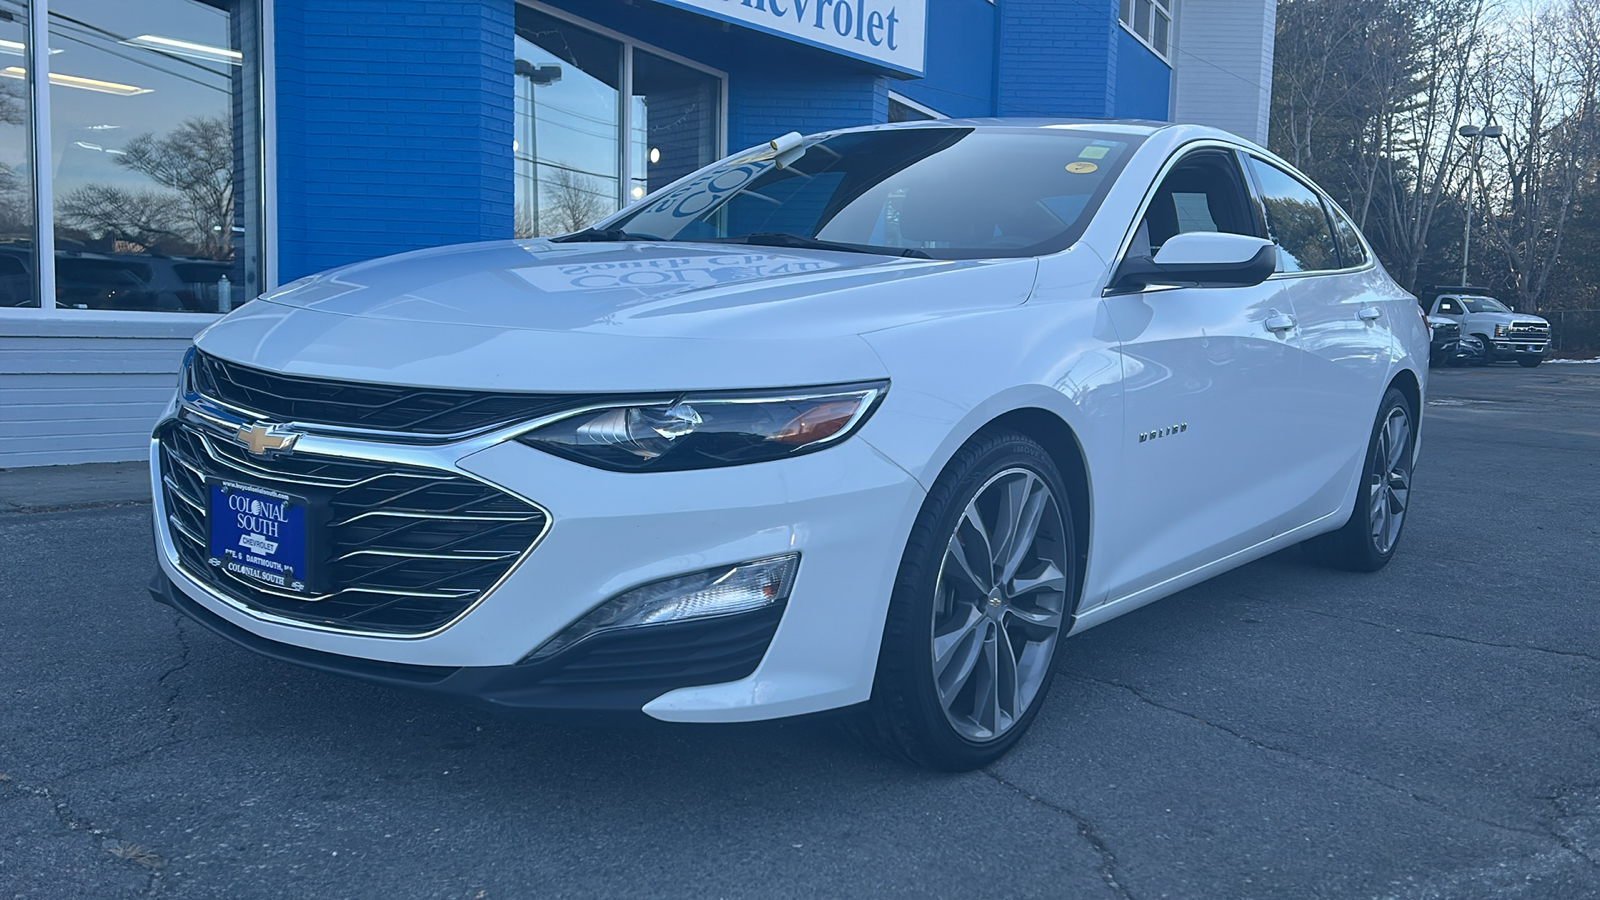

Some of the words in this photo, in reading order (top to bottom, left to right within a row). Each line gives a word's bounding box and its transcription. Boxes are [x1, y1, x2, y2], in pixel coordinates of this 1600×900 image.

[722, 0, 899, 51] vrolet
[1139, 422, 1187, 443] MALIBU
[229, 494, 288, 523] COLONIAL
[237, 513, 279, 537] SOUTH
[242, 536, 275, 552] CHEVROLET
[228, 562, 261, 579] COLONIAL
[261, 571, 285, 586] SOUTH
[245, 554, 284, 572] DARTMOUTH,
